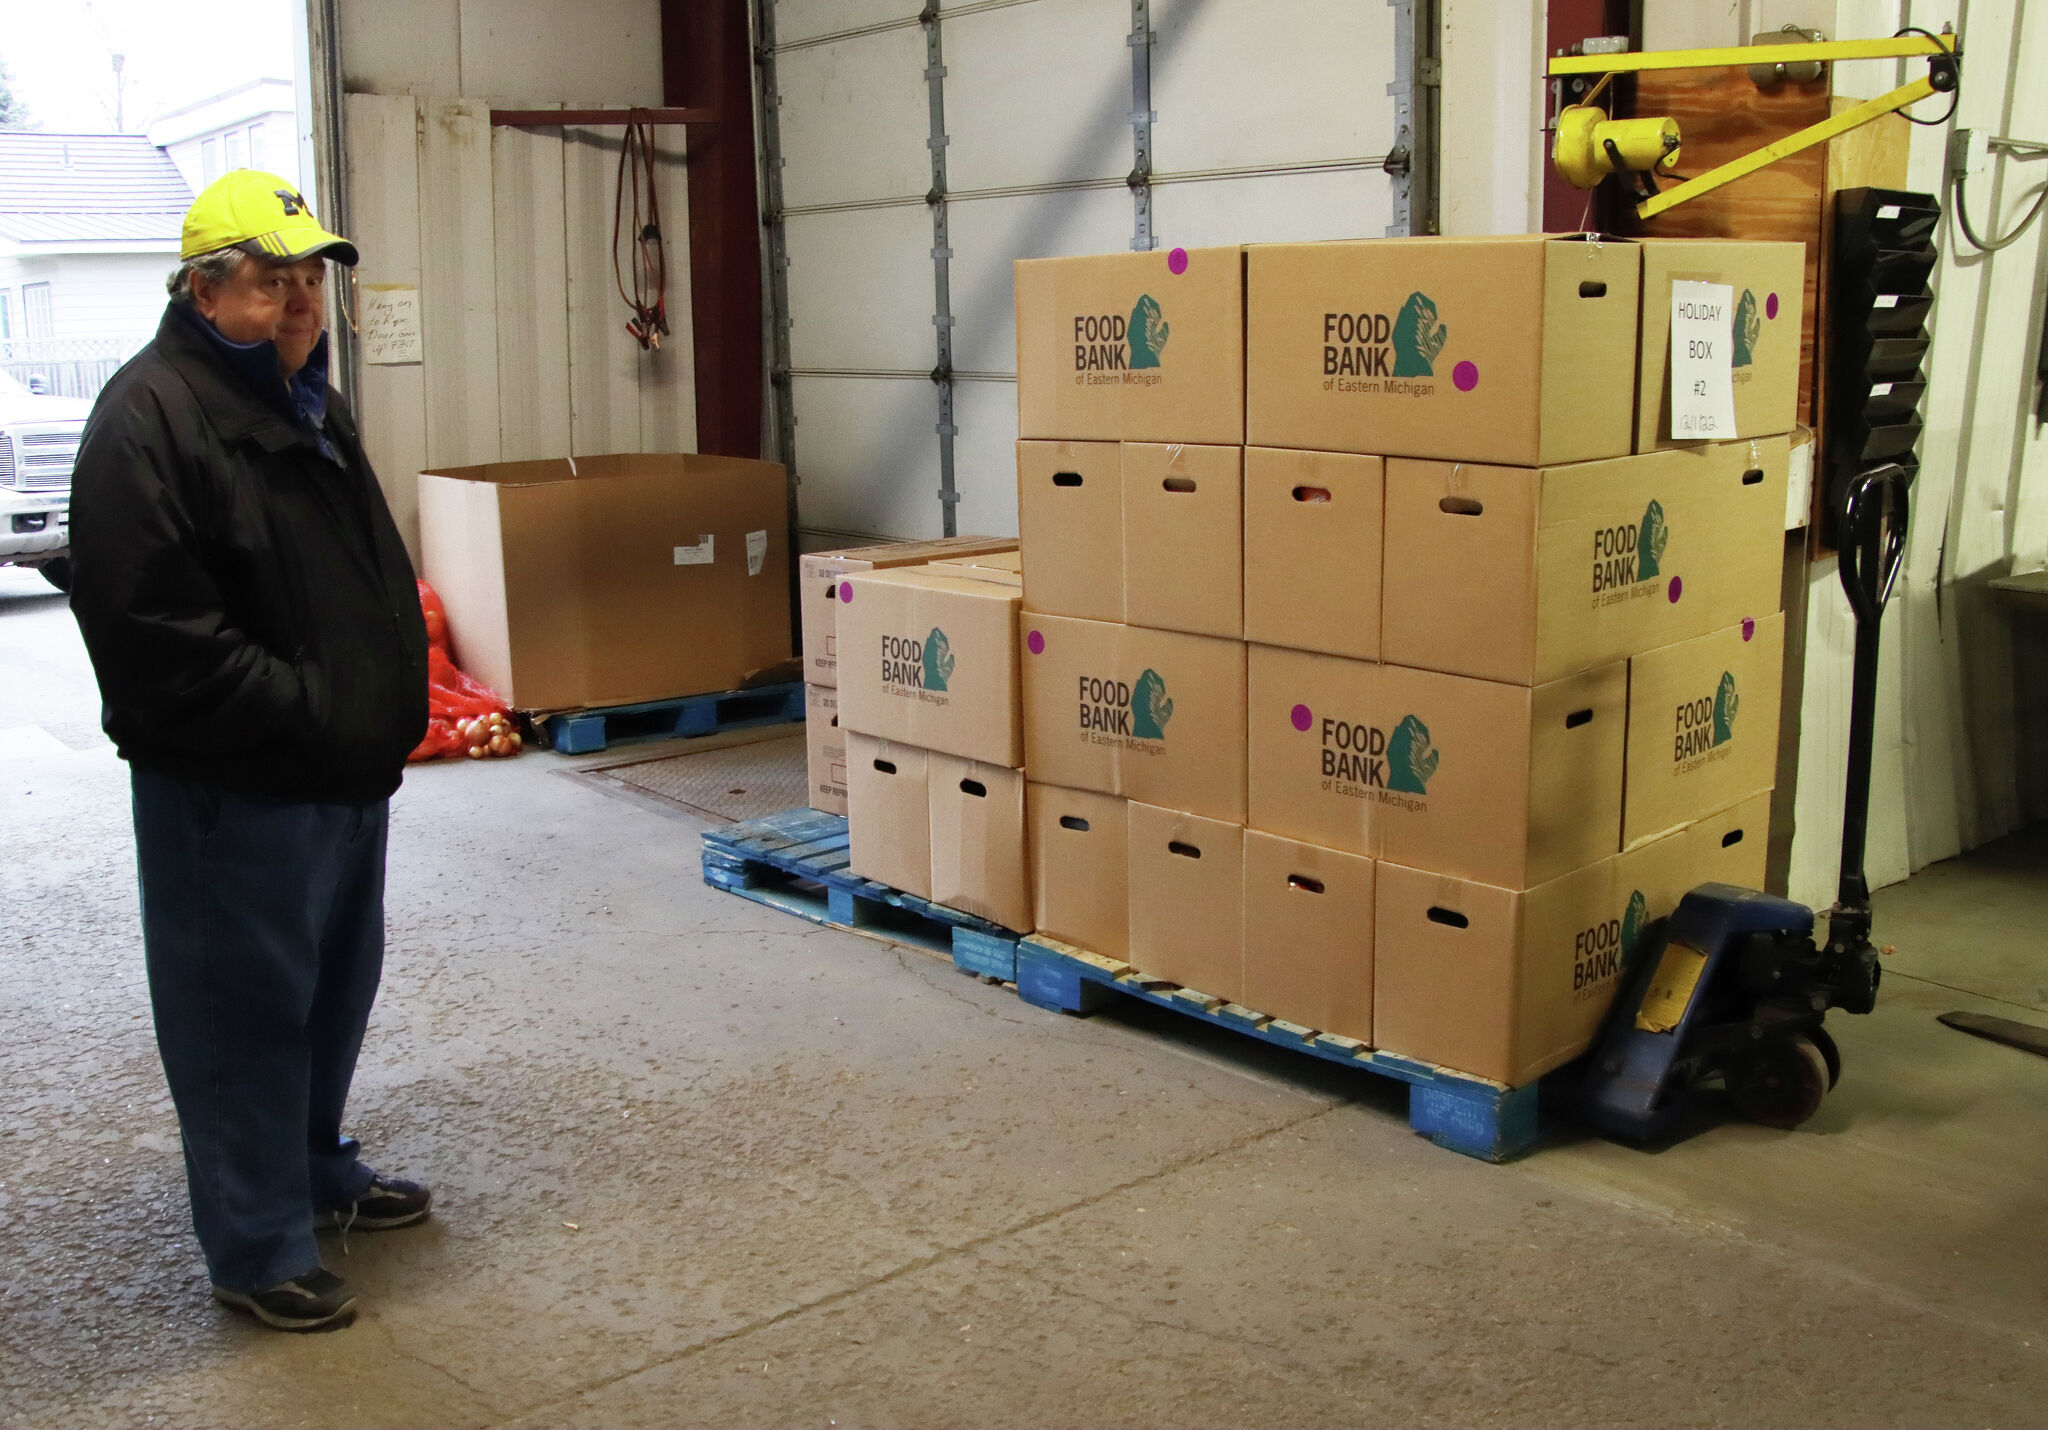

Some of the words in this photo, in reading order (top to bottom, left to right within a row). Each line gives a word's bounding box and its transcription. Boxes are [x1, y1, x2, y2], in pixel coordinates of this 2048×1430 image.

[273, 189, 314, 219] M
[1678, 302, 1722, 321] HOLIDAY
[1074, 315, 1126, 342] FOOD
[1324, 313, 1391, 344] FOOD
[1075, 344, 1127, 371] BANK
[1324, 346, 1390, 377] BANK
[1689, 340, 1713, 360] BOX
[1075, 373, 1084, 385] of
[1087, 373, 1120, 385] Eastern
[1122, 373, 1162, 387] Michigan
[1323, 378, 1334, 391] of
[1338, 379, 1380, 393] Eastern
[1384, 380, 1435, 398] Michigan
[1694, 380, 1706, 396] #2
[1594, 524, 1637, 561] FOOD
[1592, 555, 1636, 593] BANK
[1591, 598, 1600, 609] of
[1601, 590, 1628, 607] Eastern
[1630, 583, 1660, 599] Michigan
[882, 634, 922, 663] FOOD
[882, 658, 923, 688] BANK
[882, 685, 890, 694] of
[891, 684, 917, 699] Eastern
[918, 689, 949, 707] Michigan
[1080, 676, 1130, 707] FOOD
[1080, 703, 1131, 736] BANK
[1676, 696, 1713, 733] FOOD
[1080, 732, 1089, 742] of
[1091, 732, 1124, 750] Eastern
[1126, 738, 1166, 756] Michigan
[1322, 718, 1385, 756] FOOD
[1674, 723, 1712, 762] BANK
[1322, 748, 1384, 788] BANK
[820, 784, 831, 794] KEEP
[1321, 779, 1332, 791] of
[1335, 781, 1376, 800] Eastern
[1378, 790, 1428, 813] Michigan
[1575, 919, 1620, 962] FOOD
[1574, 947, 1619, 991] BANK
